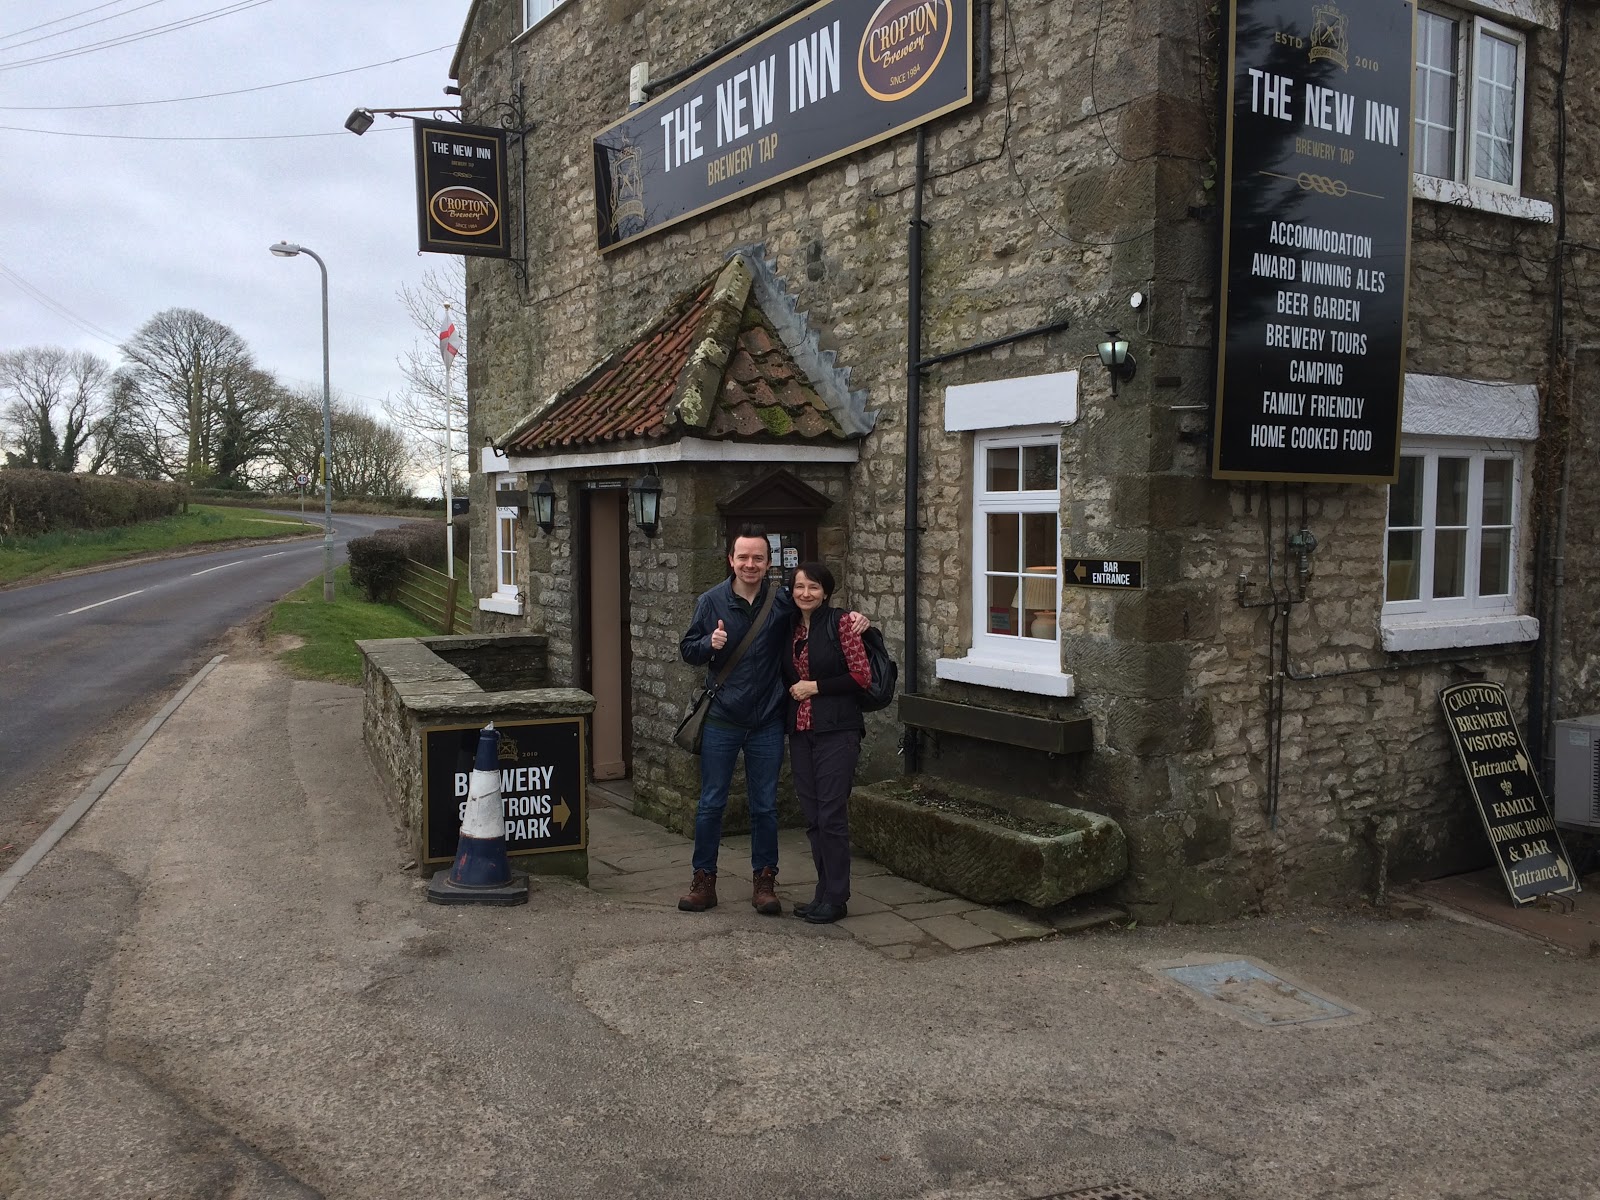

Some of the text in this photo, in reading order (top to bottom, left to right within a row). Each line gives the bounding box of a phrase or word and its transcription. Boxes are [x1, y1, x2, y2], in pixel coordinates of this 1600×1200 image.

[869, 0, 938, 63] CROPTON
[1275, 31, 1303, 49] ESTD
[880, 34, 925, 68] Brewery
[890, 63, 921, 86] SINCE 1984
[1355, 55, 1379, 72] 2010
[660, 20, 840, 173] THE NEW INN
[1249, 68, 1399, 147] THE NEW INN
[432, 141, 491, 160] THE NEW INN
[707, 132, 778, 186] BREWERY TAP
[1295, 136, 1355, 165] BREWERY TAP
[439, 196, 489, 216] CROPTON
[447, 209, 480, 220] Brewery
[1269, 220, 1372, 259] ACCOMMODATION
[1251, 252, 1385, 294] AWARD WINNING ALES
[1277, 290, 1360, 322] BEER GARDEN
[1266, 323, 1367, 356] BREWERY TOURS
[1289, 359, 1343, 386] CAMPING
[1262, 391, 1364, 419] FAMILY FRIENDLY
[1250, 424, 1372, 452] HOME COOKED FOOD
[1092, 573, 1130, 585] ENTRANCE
[1103, 561, 1119, 573] BAR
[1448, 688, 1503, 711] CROPTON
[1455, 711, 1509, 732] BREWERY
[1463, 731, 1517, 752] VISITORS
[1472, 758, 1518, 778] Entrance
[454, 765, 554, 797] BWERY
[502, 794, 551, 817] TRONS
[1492, 796, 1538, 818] FAMILY
[504, 817, 551, 841] PARK
[1491, 816, 1553, 842] DINING ROOM
[1508, 839, 1552, 862] & BAR
[1511, 863, 1558, 888] Entrance
